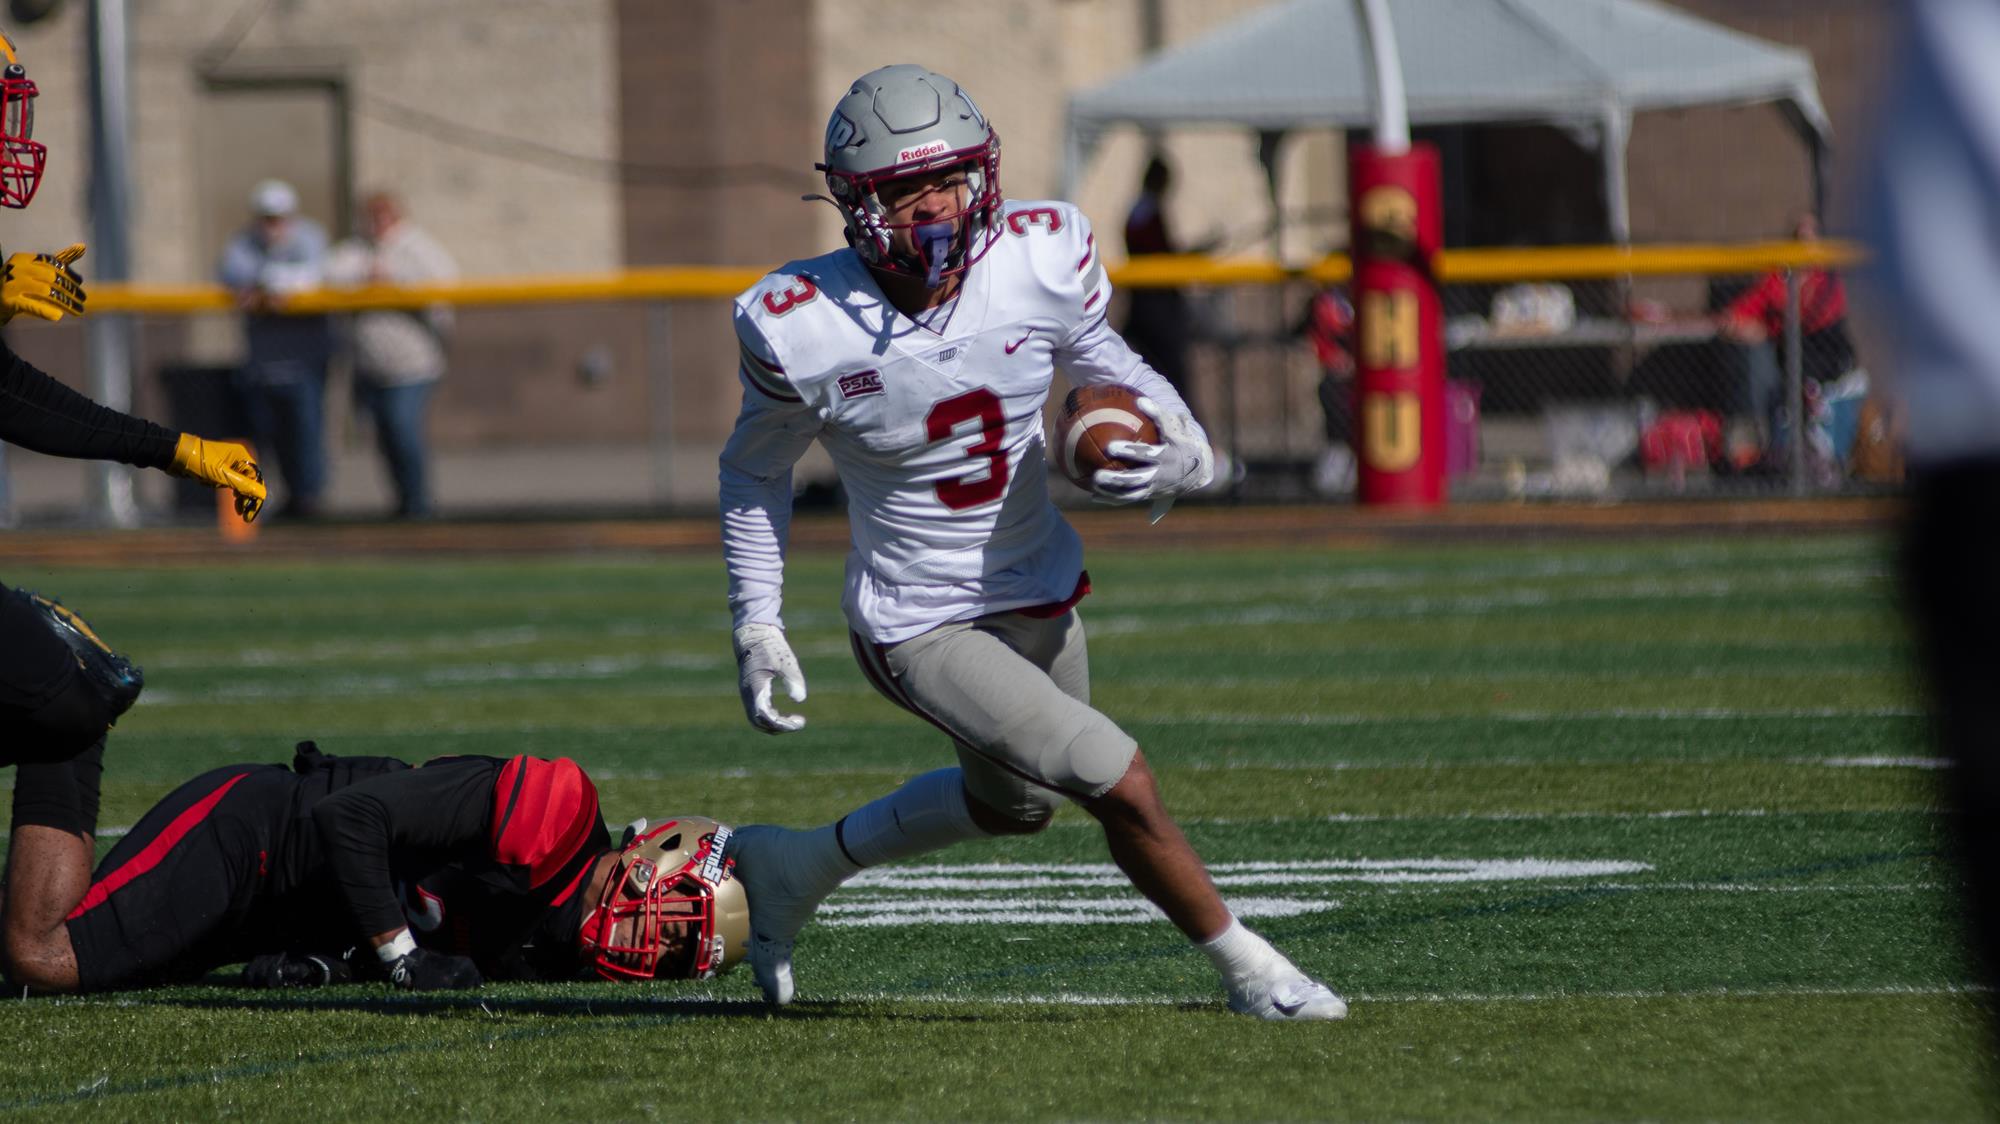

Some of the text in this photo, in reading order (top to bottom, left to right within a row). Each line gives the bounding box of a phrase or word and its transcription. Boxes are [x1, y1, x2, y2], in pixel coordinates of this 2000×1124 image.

[900, 143, 945, 162] Riddell
[1005, 207, 1065, 238] 3
[760, 274, 821, 319] 3
[840, 375, 882, 393] PSAC
[922, 384, 1010, 516] 3
